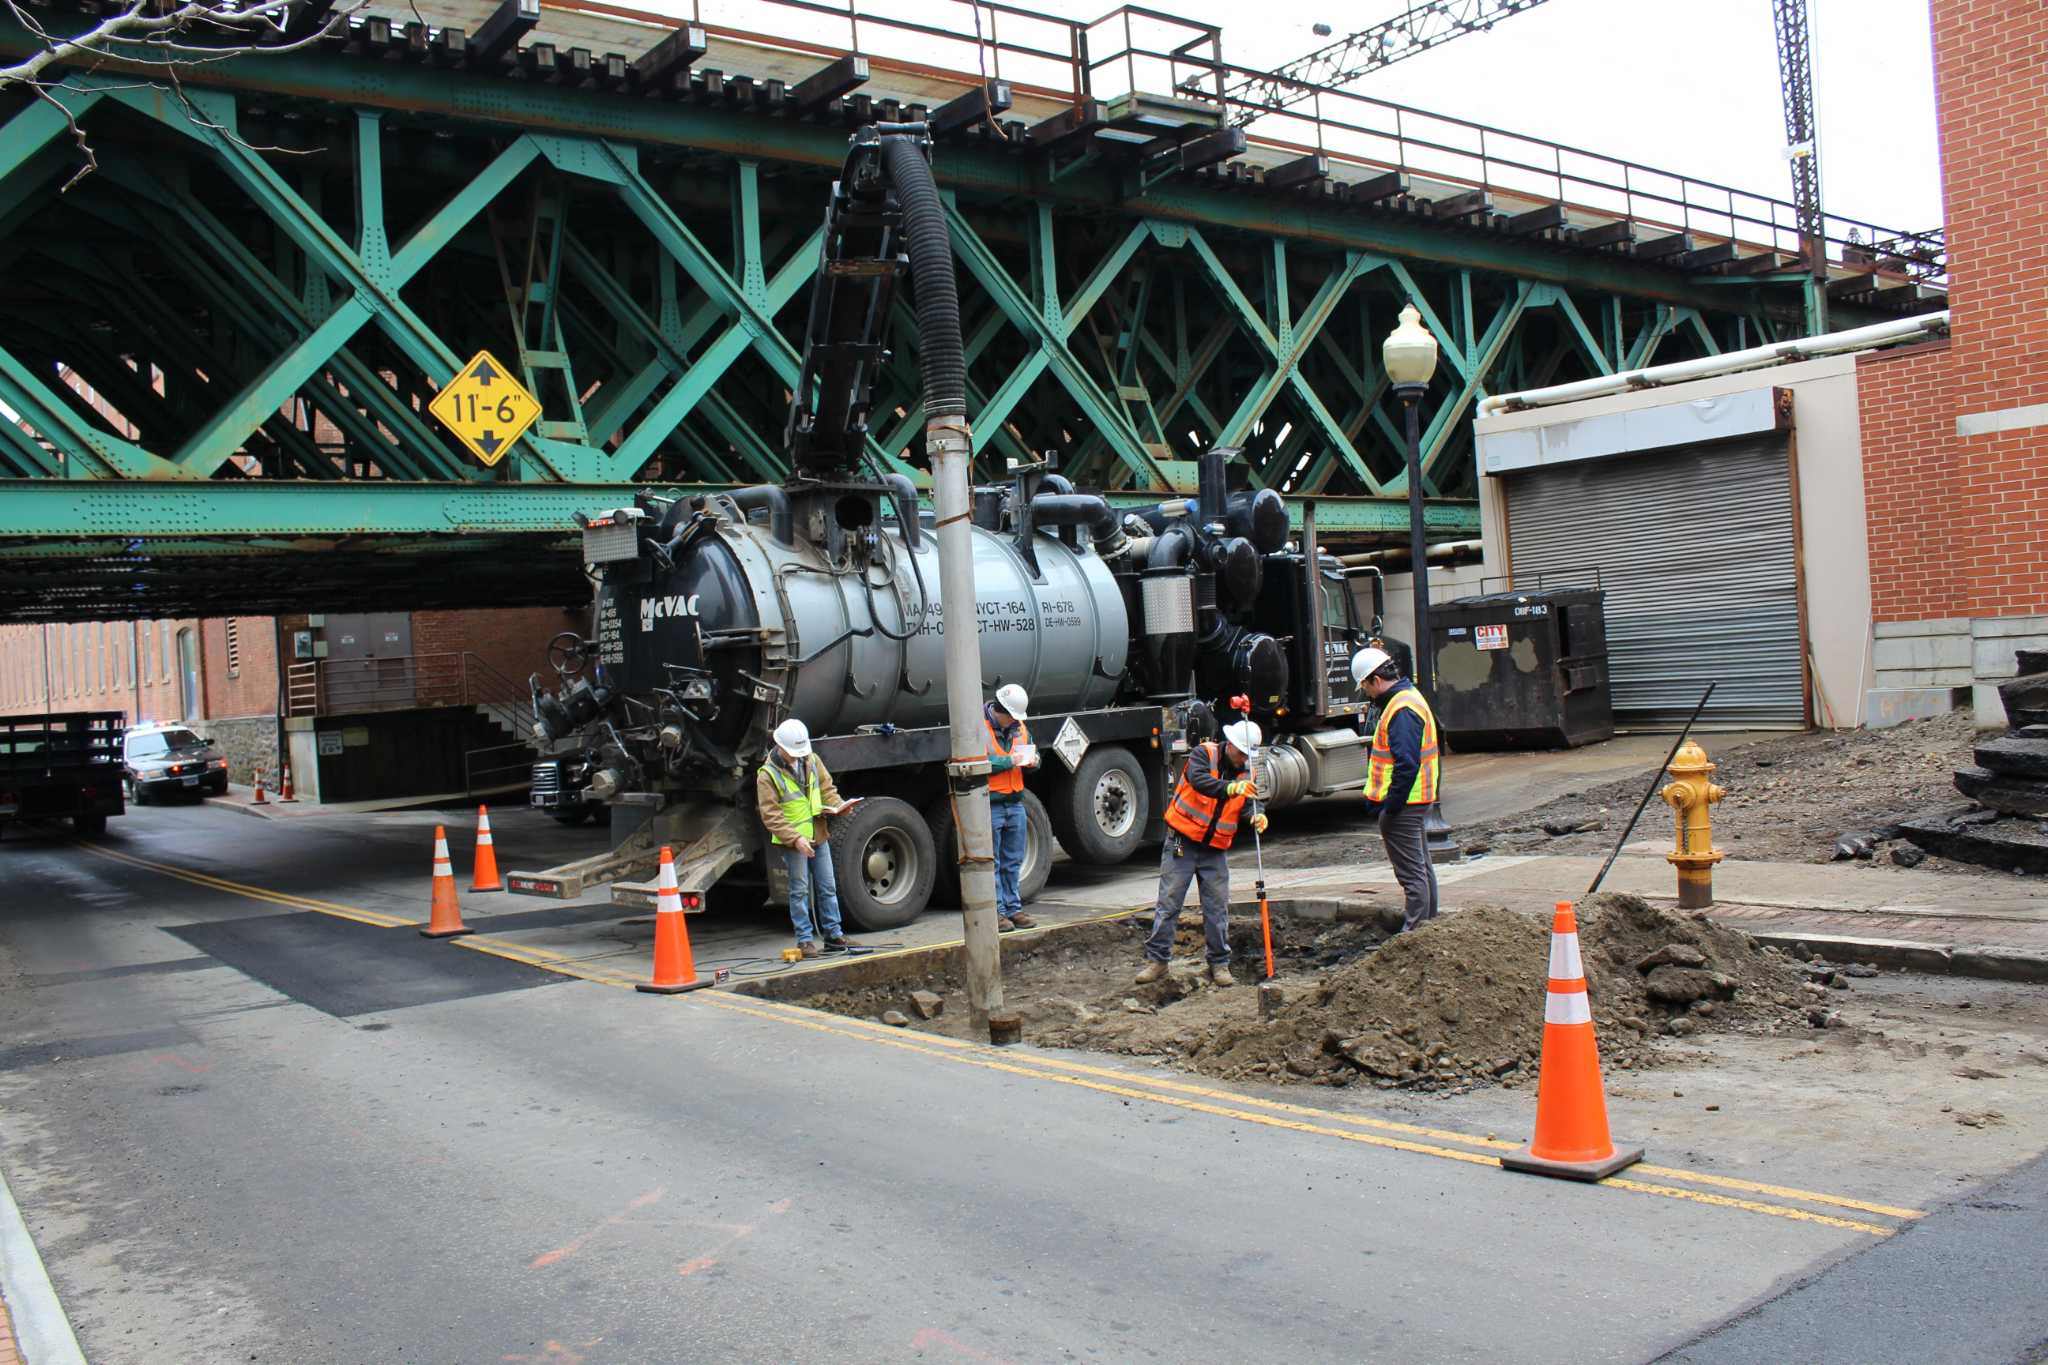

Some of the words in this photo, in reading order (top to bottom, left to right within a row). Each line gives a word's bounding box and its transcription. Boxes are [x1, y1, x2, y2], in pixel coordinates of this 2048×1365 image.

[641, 594, 700, 620] McVAC
[1041, 601, 1074, 613] RI-678
[1477, 625, 1504, 637] CITY
